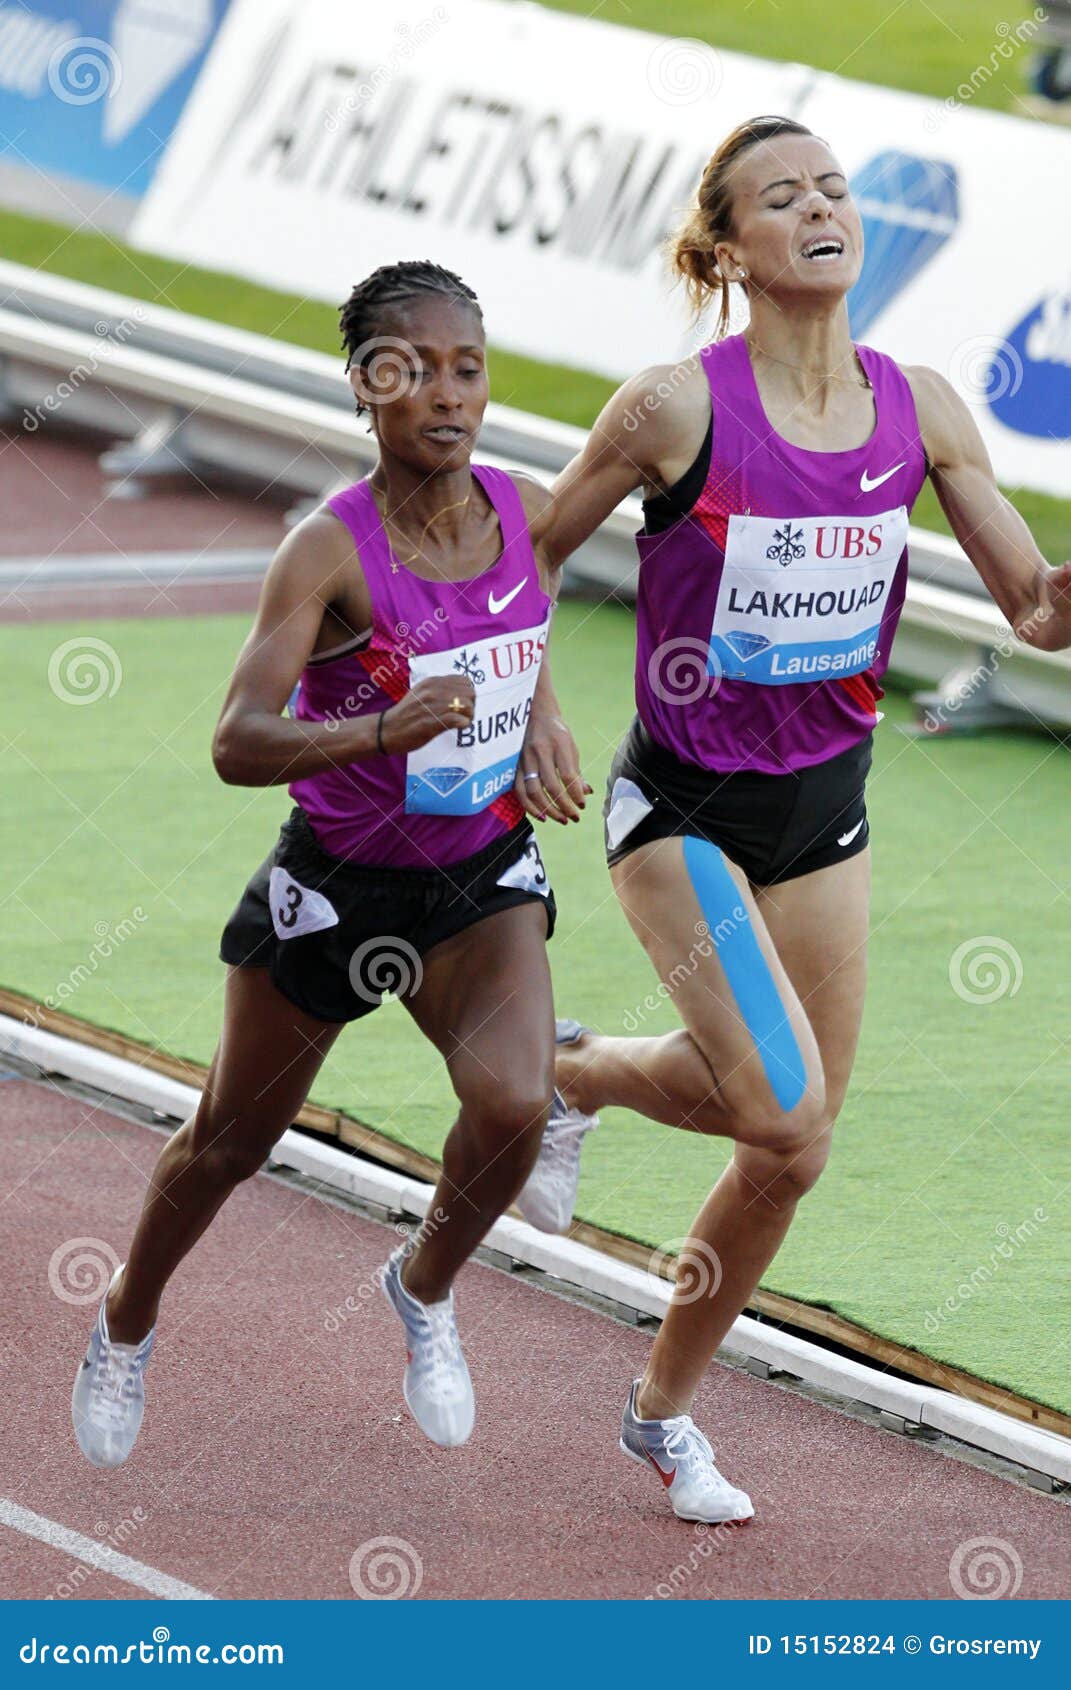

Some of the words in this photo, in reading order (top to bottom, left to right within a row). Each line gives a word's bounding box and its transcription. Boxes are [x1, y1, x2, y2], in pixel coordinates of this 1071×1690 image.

[815, 524, 883, 559] UBS
[727, 579, 886, 619] LAKHOUAD
[488, 631, 546, 680] UBS
[770, 640, 877, 677] Lausanne
[471, 766, 516, 806] Laus
[525, 841, 547, 885] 3
[278, 884, 303, 928] 3
